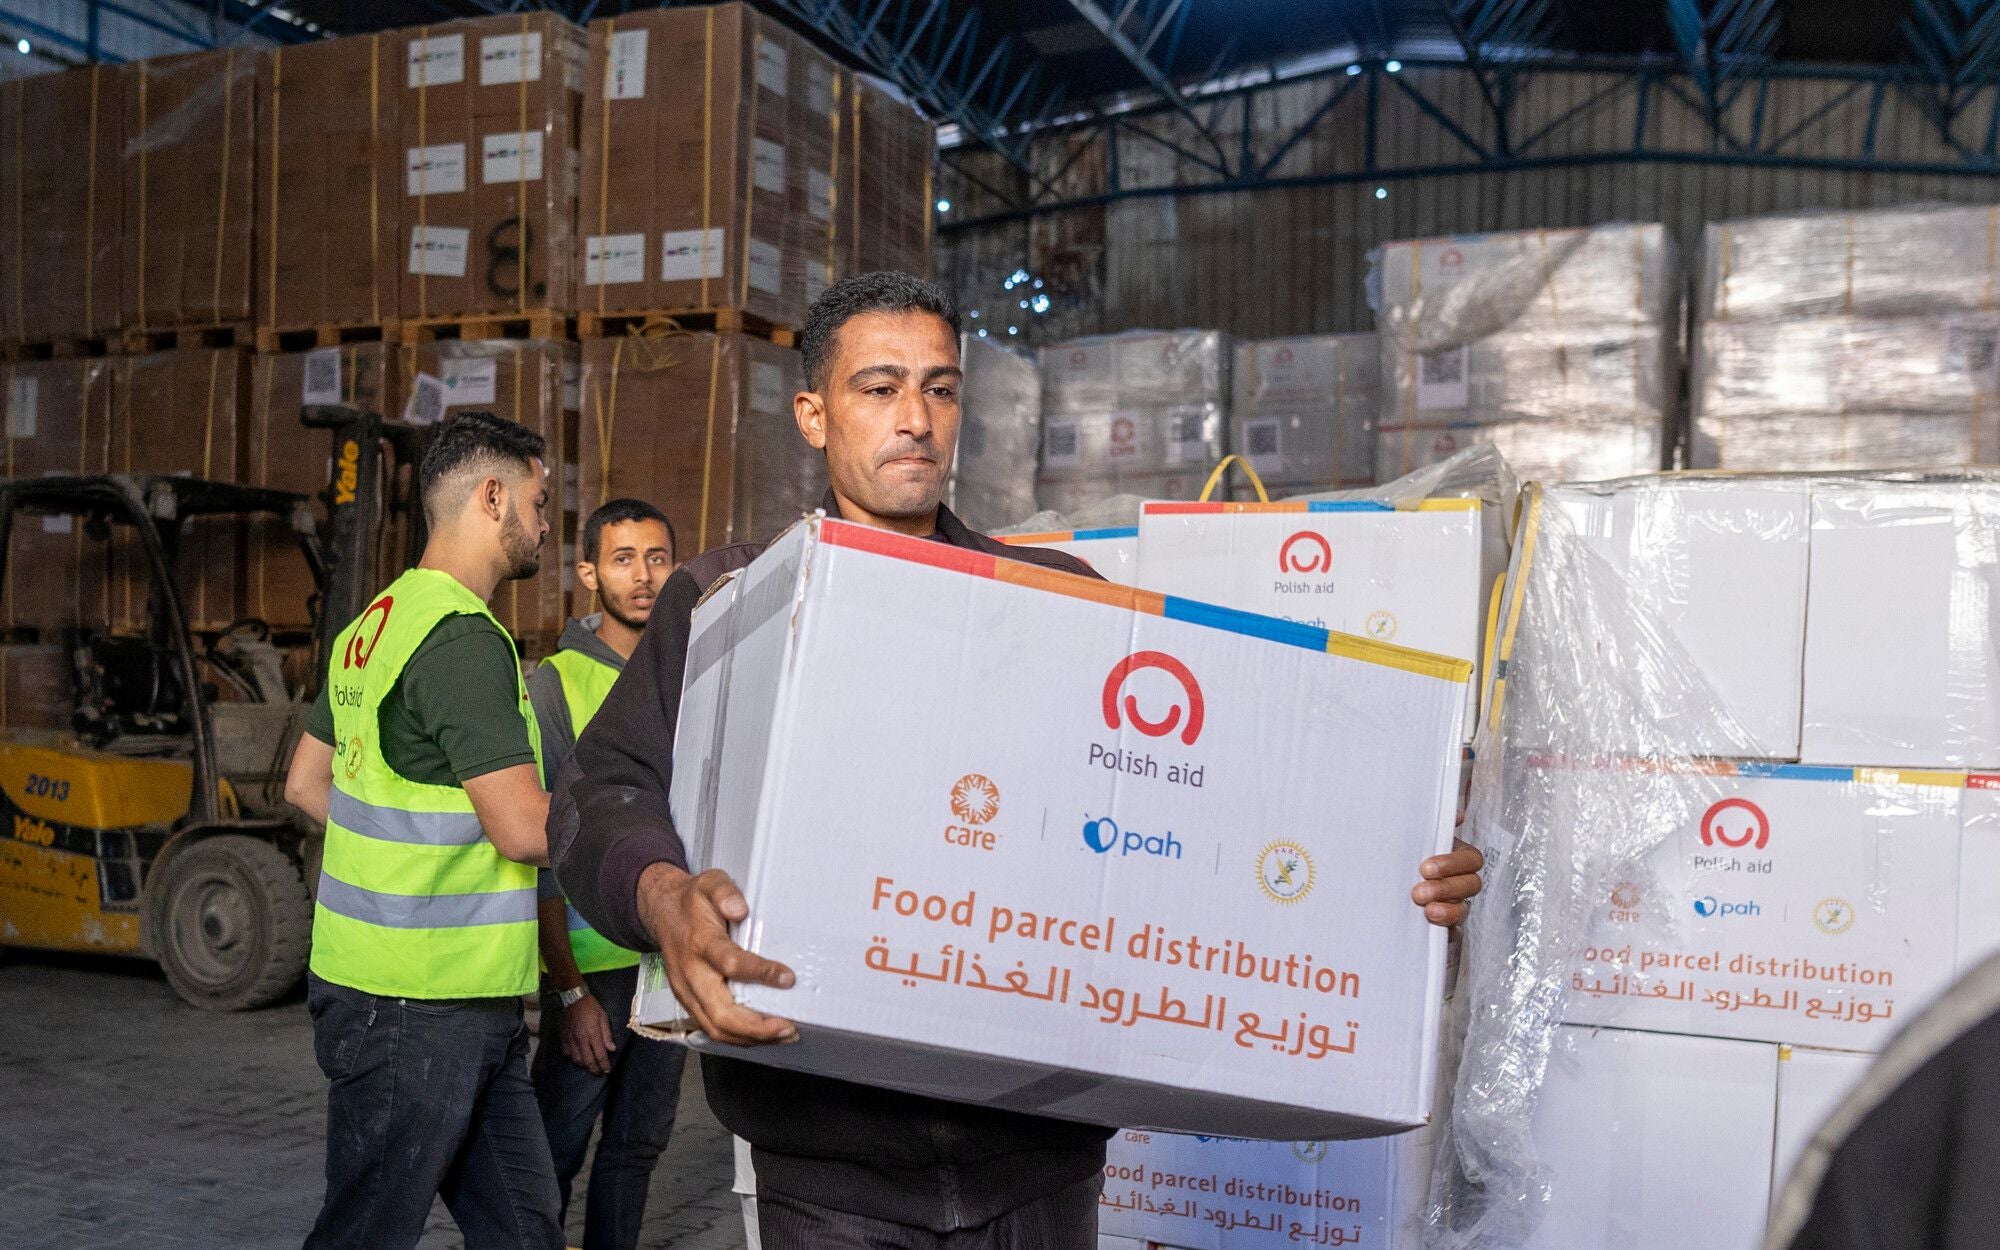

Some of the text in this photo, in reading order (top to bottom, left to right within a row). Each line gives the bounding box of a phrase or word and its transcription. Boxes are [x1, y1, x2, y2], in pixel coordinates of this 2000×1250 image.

[335, 439, 360, 505] Yale
[1274, 581, 1334, 594] Polish aid
[1088, 743, 1205, 787] Polish aid
[26, 773, 71, 801] 2013
[14, 815, 56, 846] Yale
[944, 824, 996, 851] care
[1122, 831, 1183, 859] pah
[1746, 860, 1772, 874] aid
[1608, 910, 1640, 923] care
[1720, 900, 1760, 917] pah
[872, 876, 1360, 998] Food parcel distribution
[1582, 944, 1893, 986] ood parcel distribution
[864, 935, 1360, 1059] توزيع الطرود الغذائية
[1702, 987, 1798, 1012] الطرود
[1805, 997, 1894, 1023] توزيع
[1124, 1131, 1151, 1145] care
[1105, 1164, 1361, 1213] ood parcel distribution
[1099, 1190, 1361, 1246] توزيع الطرود الغذائي
